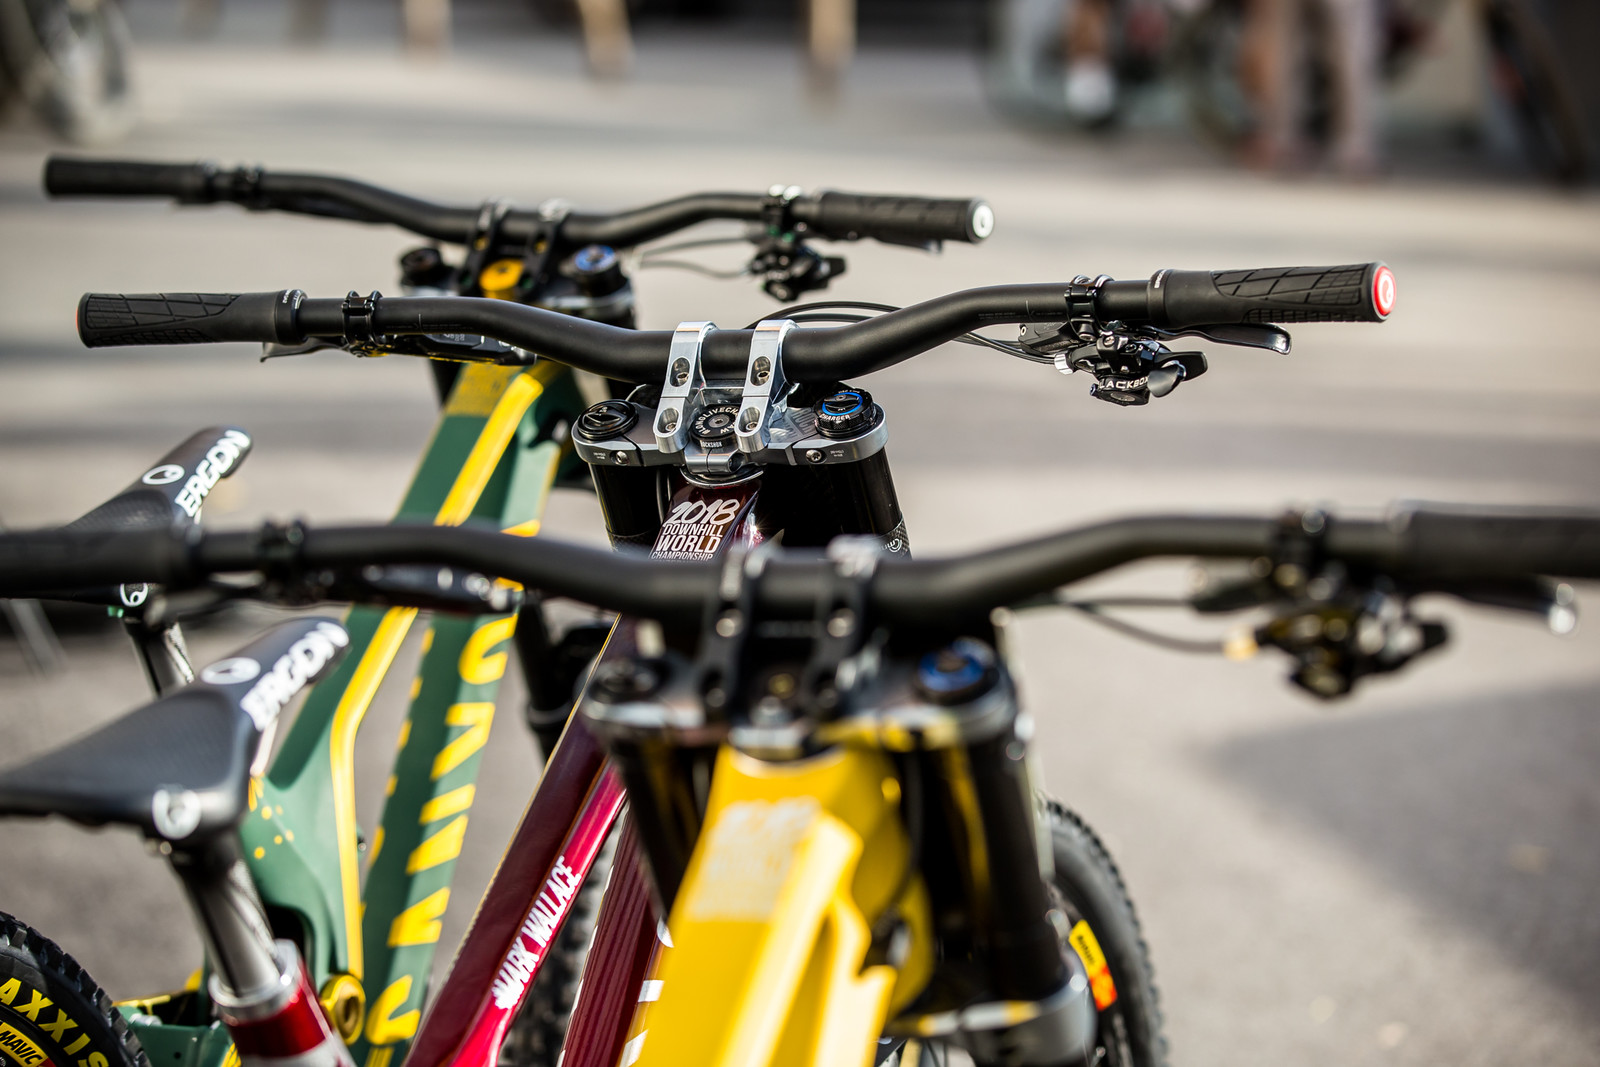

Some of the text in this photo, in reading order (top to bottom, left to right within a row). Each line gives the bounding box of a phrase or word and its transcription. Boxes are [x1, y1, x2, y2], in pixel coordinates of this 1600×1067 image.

[174, 429, 250, 517] ERGON
[662, 499, 740, 527] 2018
[655, 535, 721, 554] WORLD
[662, 523, 724, 538] DOWNHILL
[651, 551, 714, 561] CHAMPIONSHIP
[241, 621, 349, 731] ERGON
[493, 855, 582, 1002] MARK WALLACE
[0, 1030, 43, 1065] MAVIC
